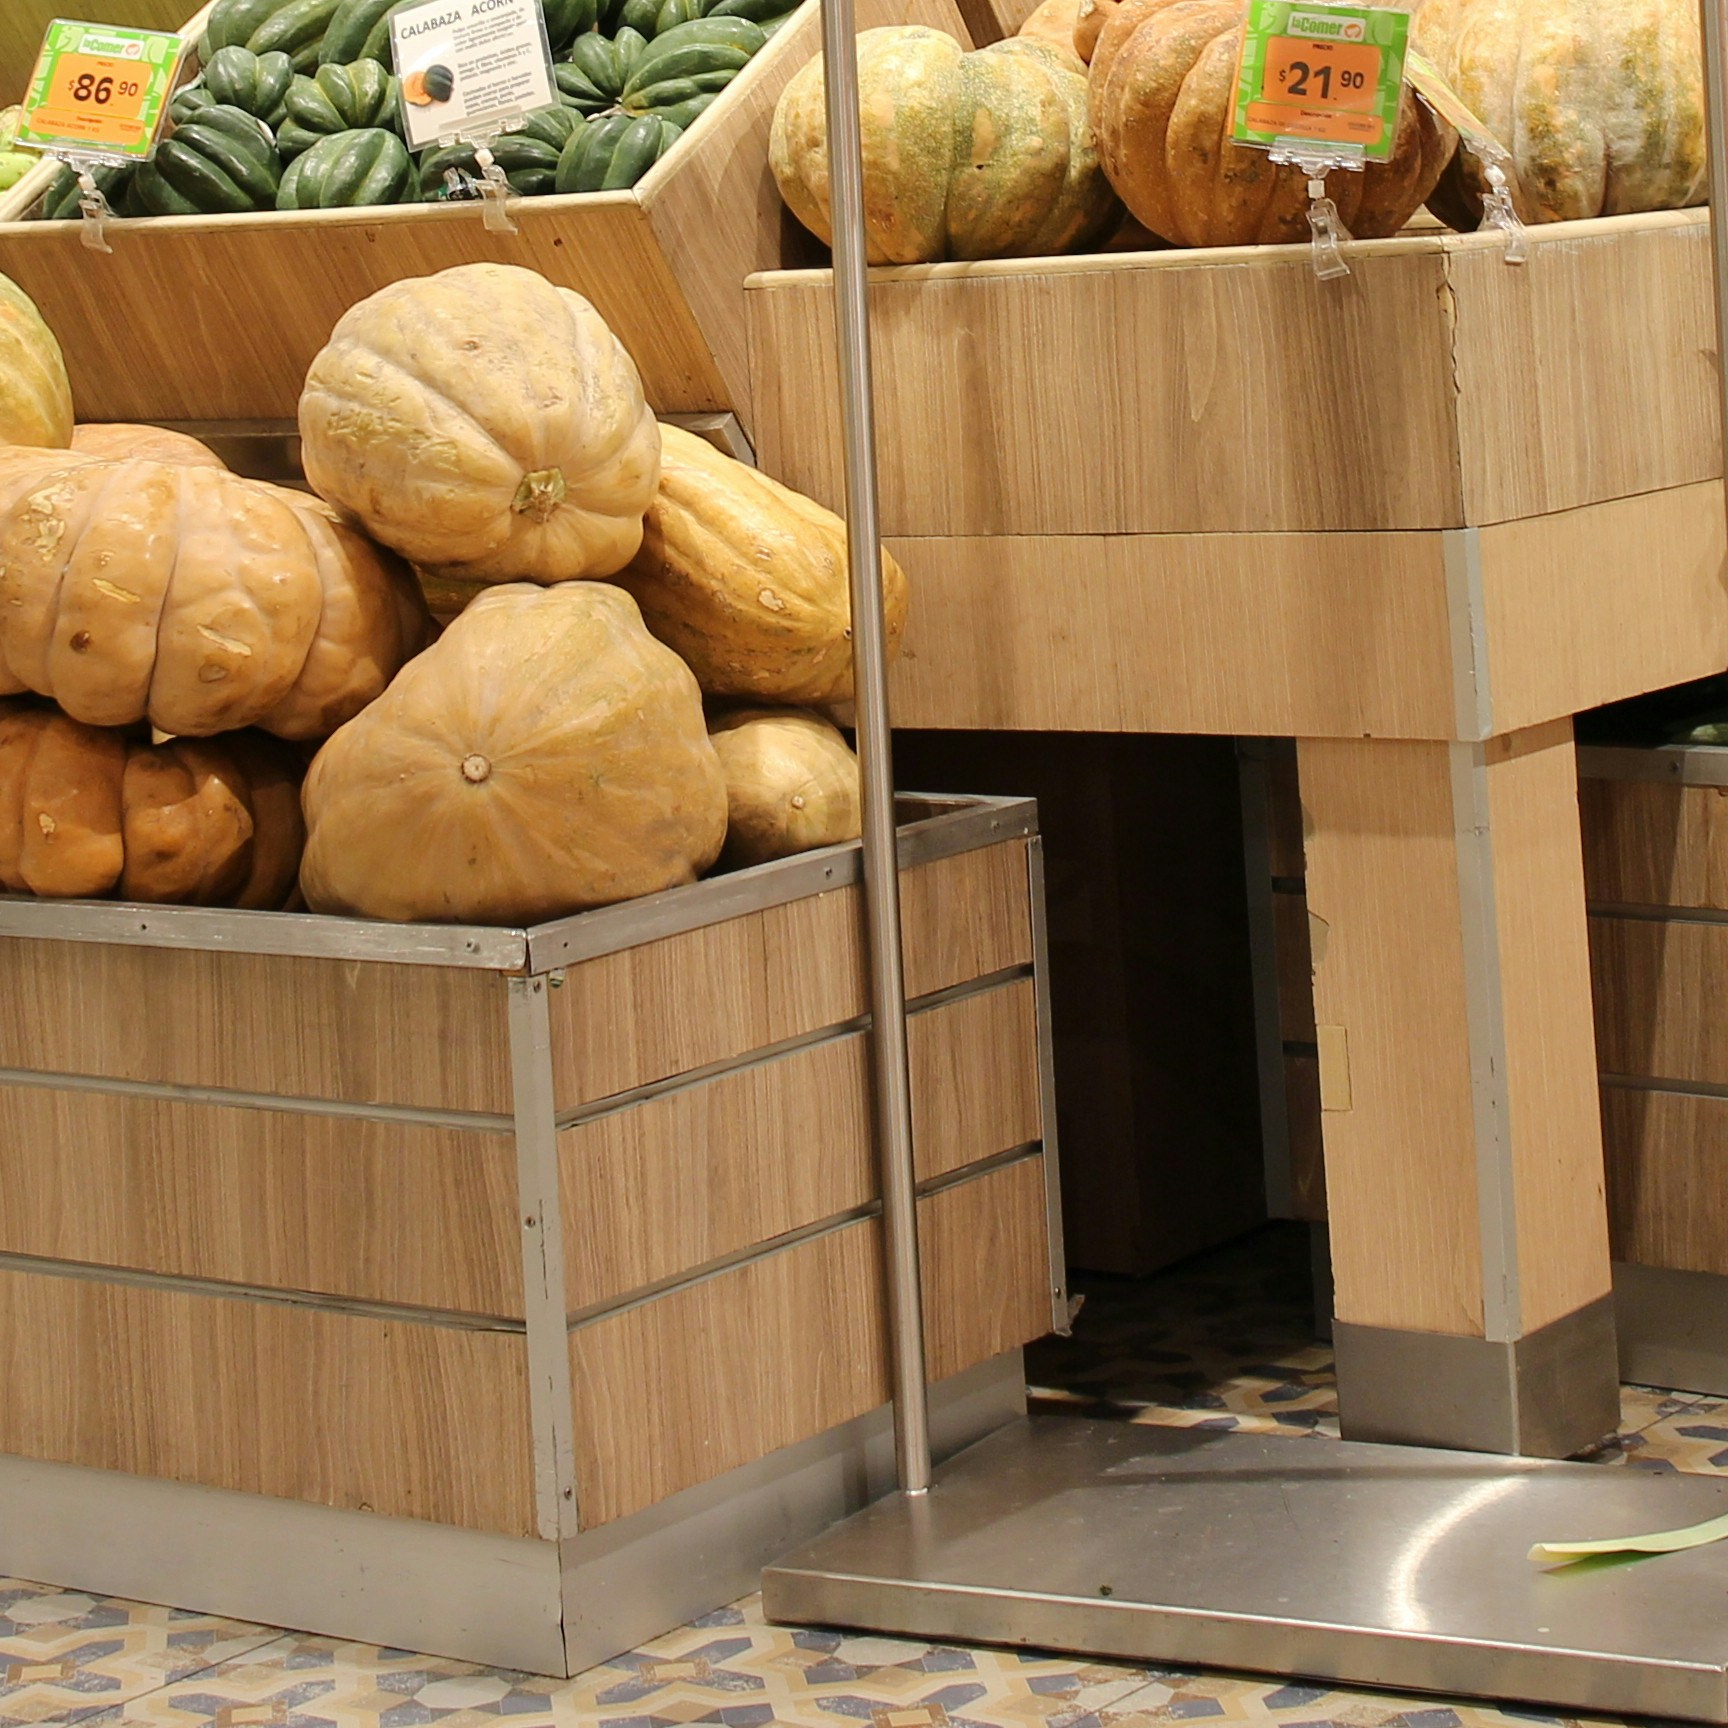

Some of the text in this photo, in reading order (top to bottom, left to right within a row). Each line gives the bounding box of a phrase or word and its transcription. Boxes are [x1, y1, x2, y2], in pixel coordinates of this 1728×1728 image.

[400, 10, 462, 40] CALABAZA
[1292, 16, 1343, 36] laComer
[1340, 70, 1365, 89] 90
[117, 81, 139, 98] 90
